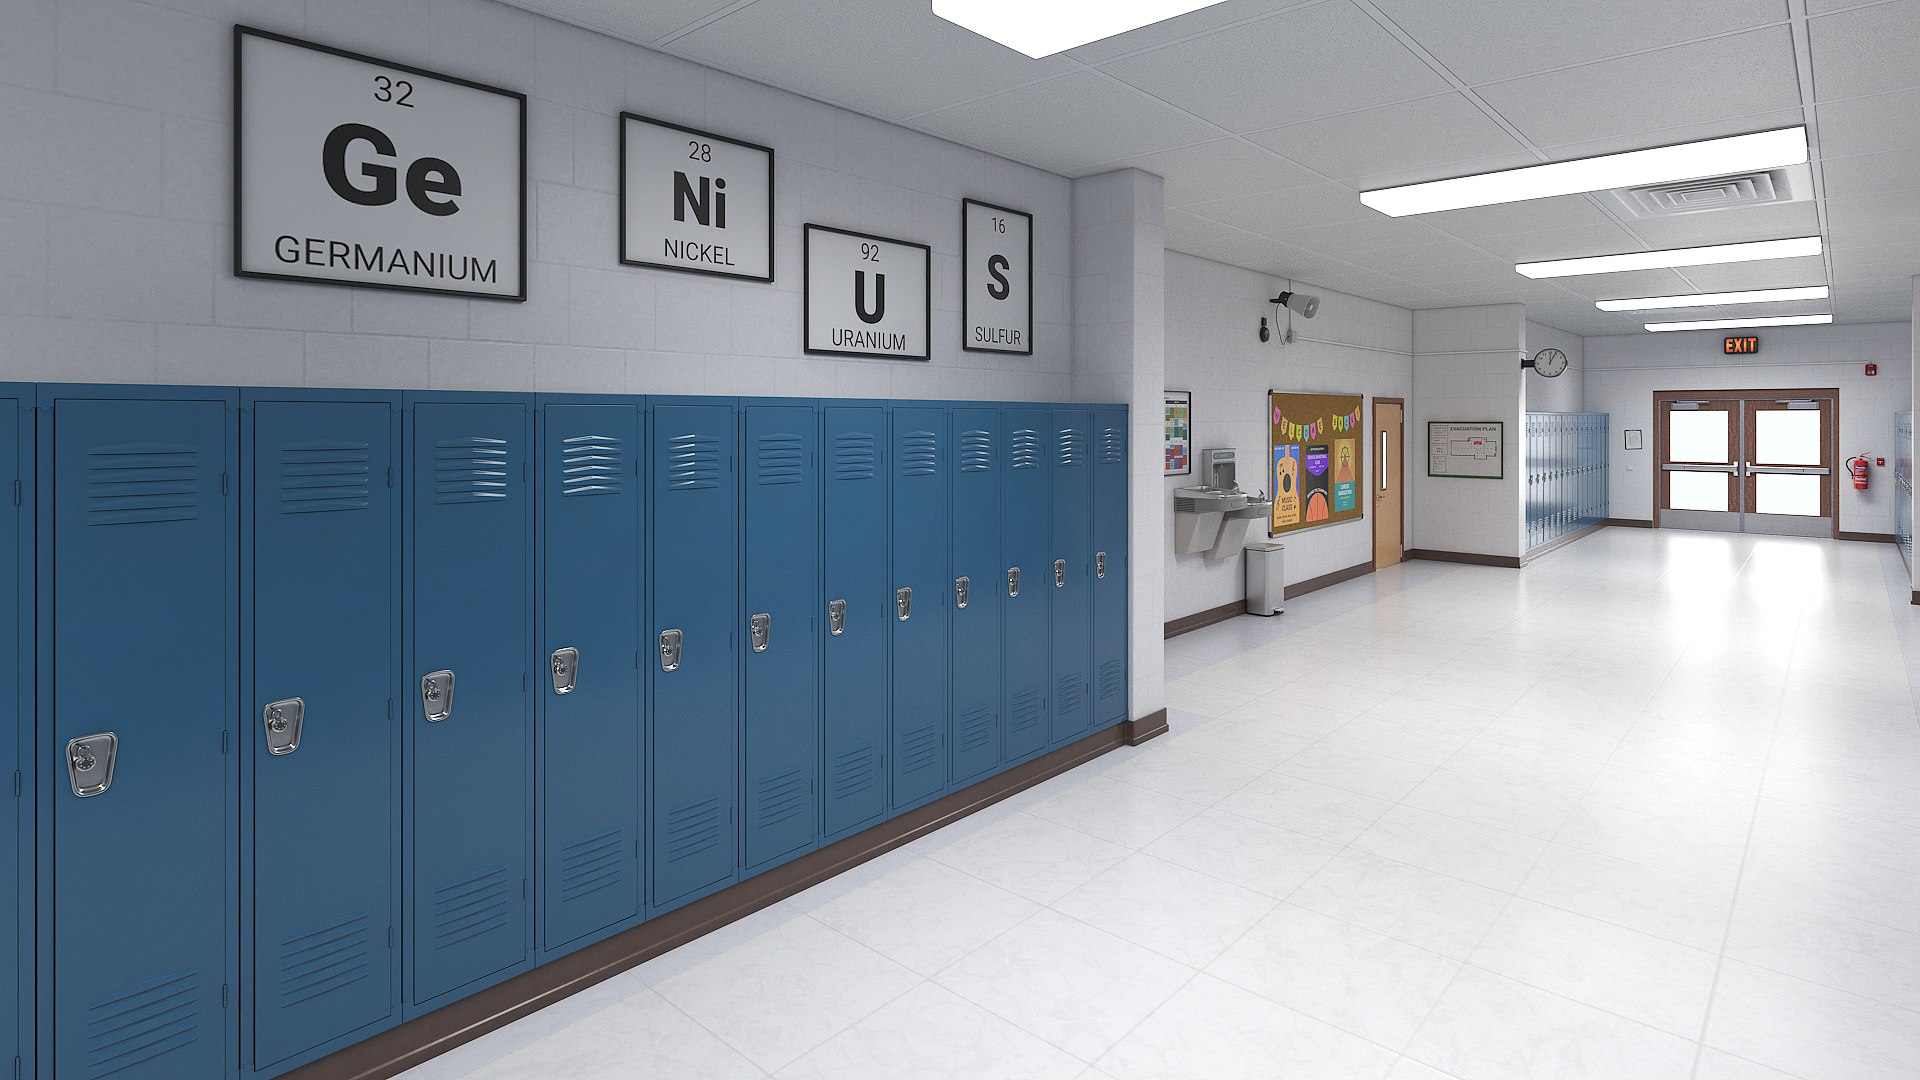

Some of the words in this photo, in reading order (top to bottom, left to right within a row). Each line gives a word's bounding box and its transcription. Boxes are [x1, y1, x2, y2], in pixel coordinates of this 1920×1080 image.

[374, 75, 415, 108] 32
[688, 141, 712, 163] 28
[323, 123, 461, 216] Ge
[674, 170, 726, 229] Ni
[991, 217, 1006, 234] 16
[274, 235, 497, 284] GERMANIUM
[664, 238, 735, 266] NICKEL
[861, 242, 880, 262] 92
[986, 254, 1010, 300] S
[855, 270, 885, 324] U
[832, 328, 906, 351] URANIUM
[975, 327, 1020, 345] SULFUR
[1725, 338, 1757, 353] EXIT
[1282, 496, 1293, 504] MUSIC
